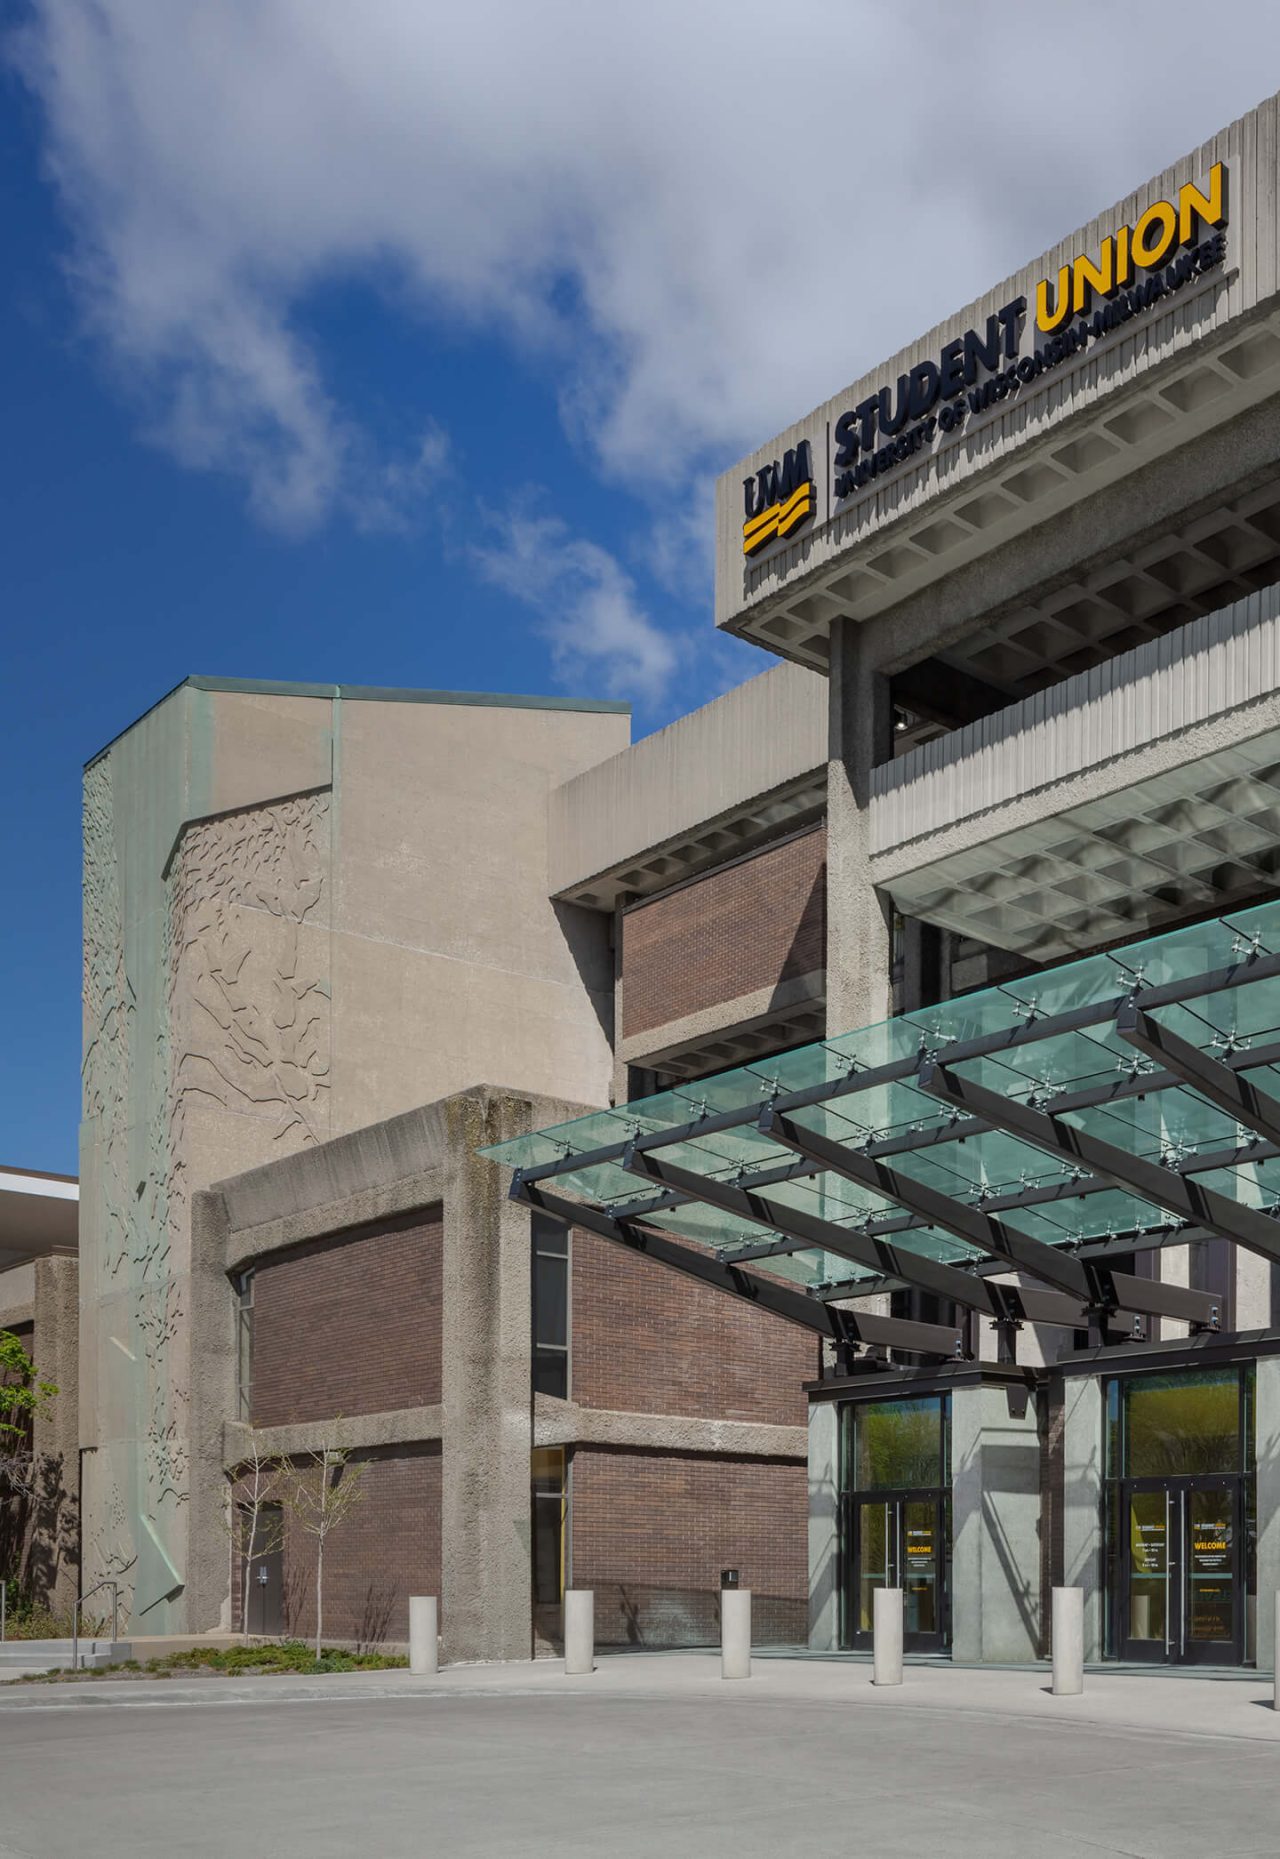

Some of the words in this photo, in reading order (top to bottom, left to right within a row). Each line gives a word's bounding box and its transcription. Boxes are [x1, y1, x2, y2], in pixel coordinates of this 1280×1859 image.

[834, 295, 1027, 467] STUDENT
[1036, 161, 1229, 336] UNION
[742, 439, 813, 519] UWM
[834, 417, 937, 498] UNIVERSITY
[938, 398, 969, 433] OF
[1194, 1541, 1226, 1550] WELCOME
